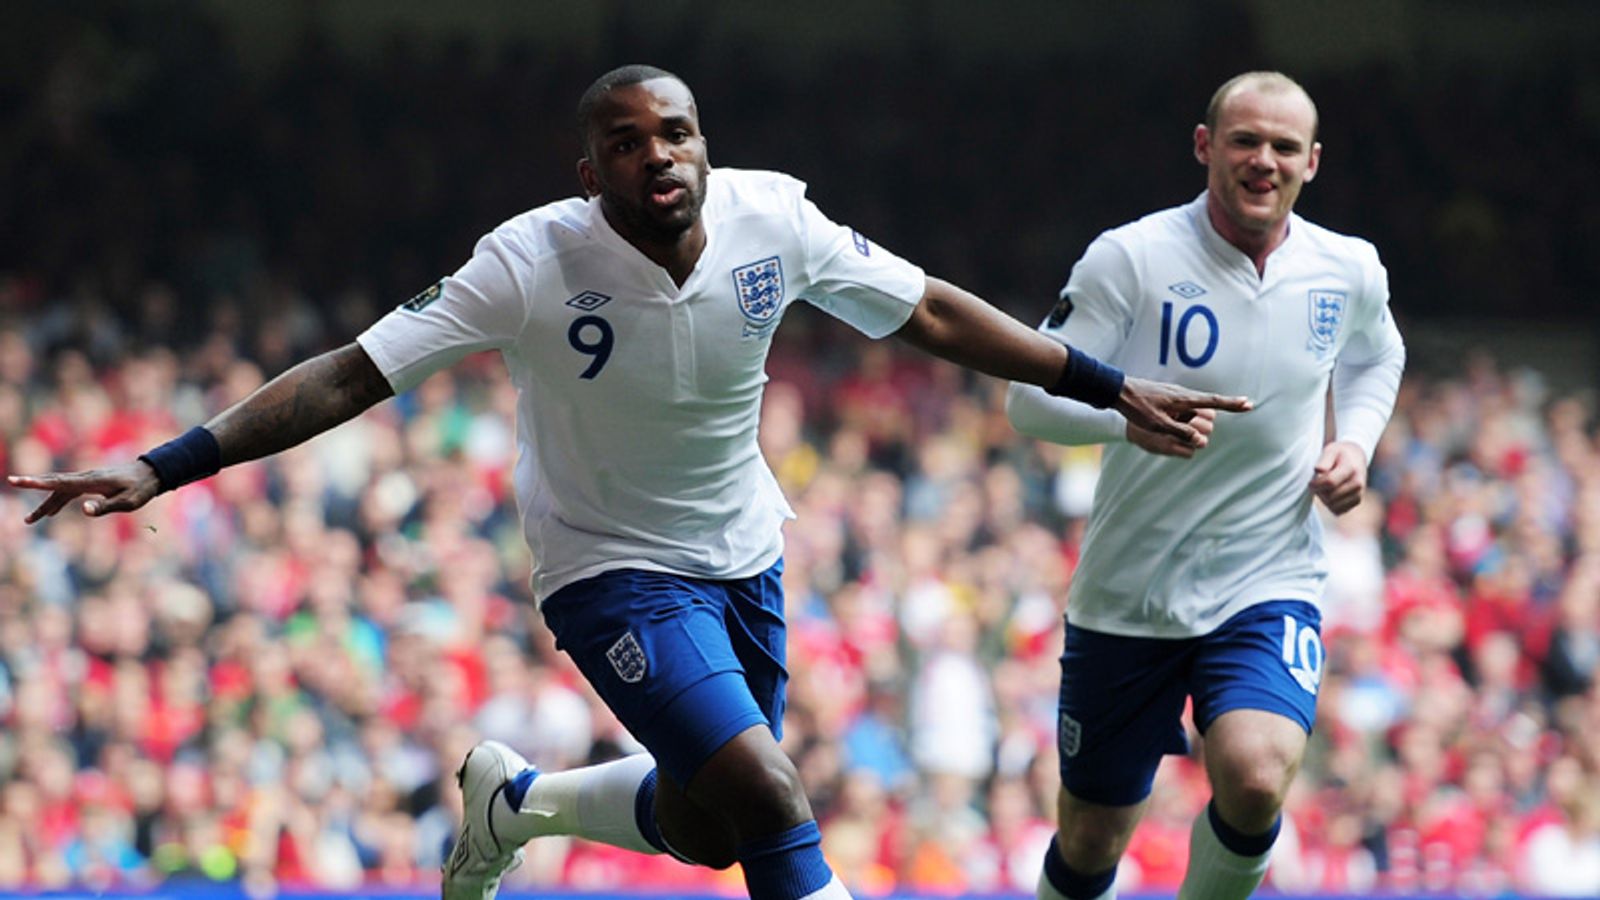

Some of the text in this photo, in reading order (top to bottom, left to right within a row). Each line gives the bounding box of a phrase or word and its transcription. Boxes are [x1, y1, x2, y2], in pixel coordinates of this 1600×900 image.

[568, 315, 615, 380] 9
[1159, 301, 1219, 368] 10
[1282, 614, 1322, 695] 10
